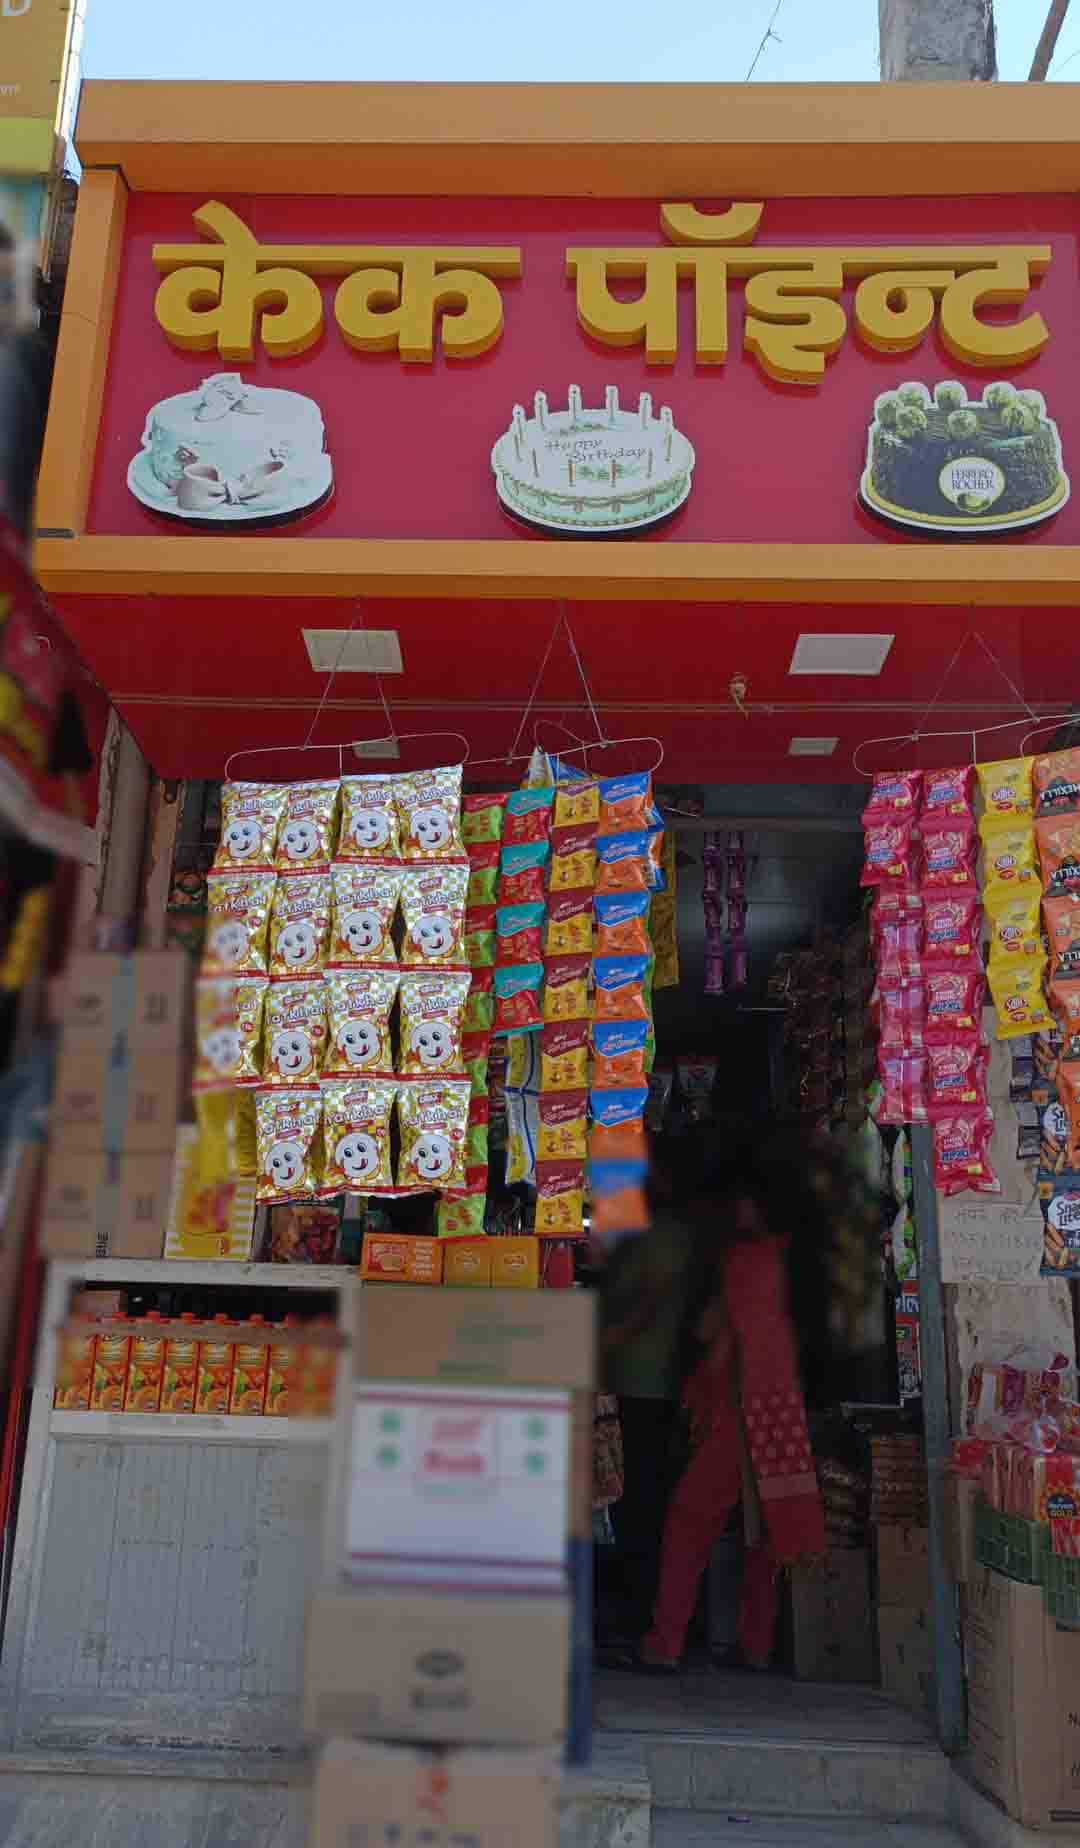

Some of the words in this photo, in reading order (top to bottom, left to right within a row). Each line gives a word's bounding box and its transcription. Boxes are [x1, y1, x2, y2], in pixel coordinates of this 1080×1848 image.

[152, 199, 522, 364] केक
[565, 202, 1052, 386] पॉइन्ट
[1056, 1201, 1080, 1217] Sna
